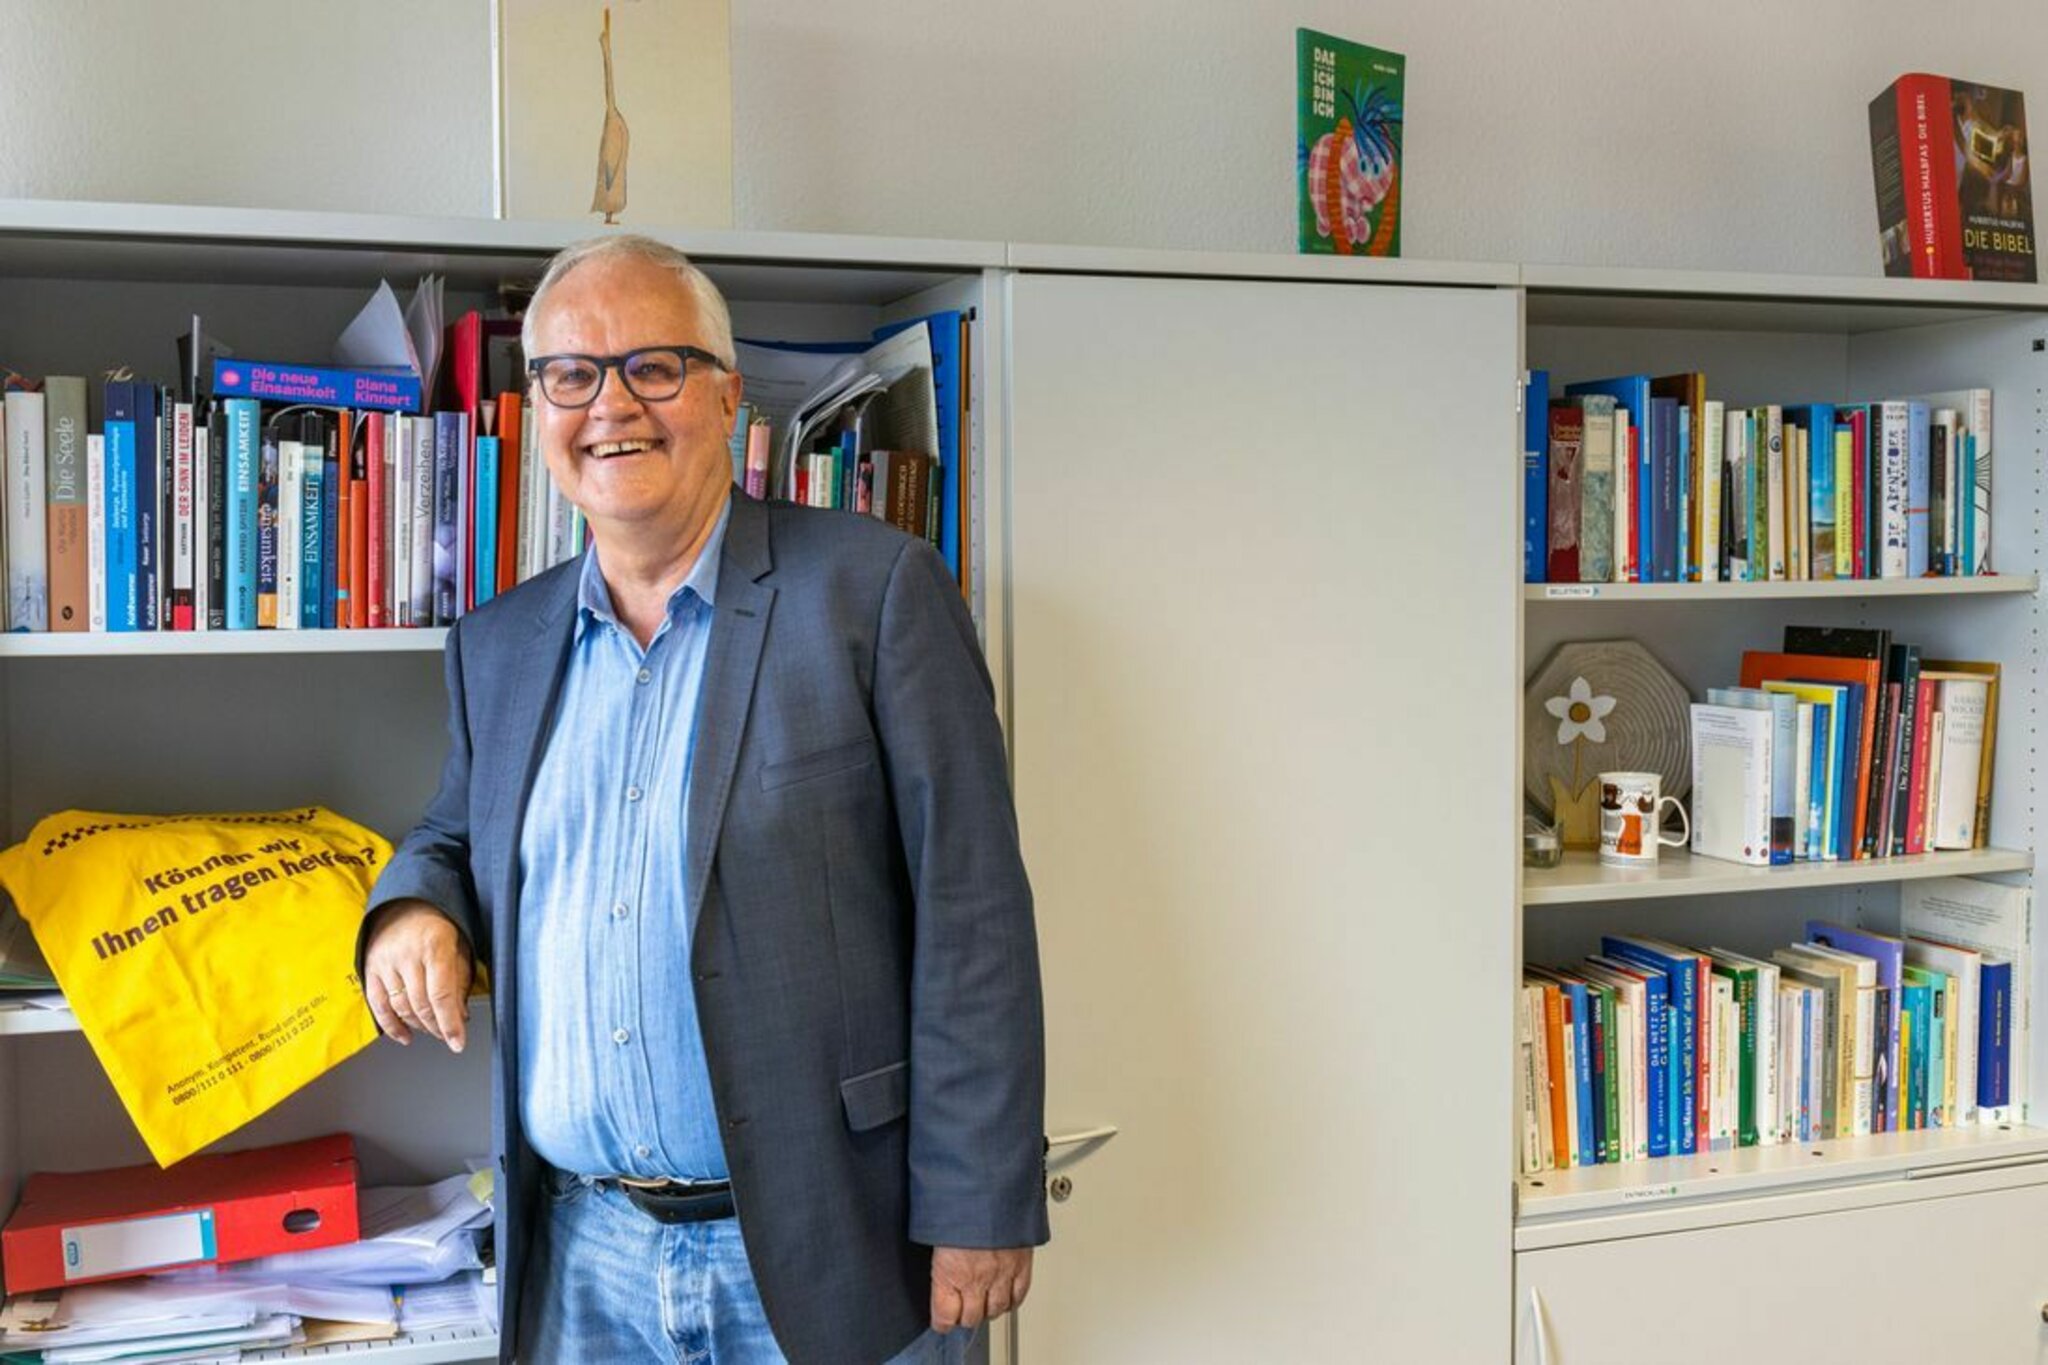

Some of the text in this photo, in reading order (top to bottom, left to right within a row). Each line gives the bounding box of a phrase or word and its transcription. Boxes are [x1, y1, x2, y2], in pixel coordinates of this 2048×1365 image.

[1313, 47, 1336, 66] DAS
[1312, 101, 1334, 119] ICH
[1917, 93, 1927, 121] BIBEL
[1918, 123, 1928, 139] DIE
[1921, 193, 1934, 245] HUBERTUS
[1964, 229, 2033, 255] DIE BIBEL
[251, 367, 318, 385] Die neue
[251, 380, 337, 399] Einsamkeit
[355, 377, 398, 393] Diana
[354, 391, 411, 407] Kinnert
[179, 412, 190, 450] LEIDEN
[54, 417, 75, 500] Die Seele
[179, 452, 190, 465] IM
[238, 408, 251, 493] EINSAMKEIT
[179, 467, 190, 493] SINN
[416, 437, 431, 520] Verzeihen
[179, 495, 190, 517] DER
[305, 478, 319, 564] EINSAMKEIT
[260, 503, 277, 583] einsamkeit
[126, 572, 136, 626] Kohlhammer
[146, 572, 156, 626] Kohlhammer
[144, 838, 302, 895] Können wir
[91, 846, 378, 961] Ihnen tragen helfen?
[1650, 994, 1658, 1013] DER
[1650, 1017, 1658, 1044] NETZ
[167, 1068, 205, 1094] Anonym.
[207, 1039, 259, 1072] Kompetent.
[258, 1022, 281, 1042] Rund
[226, 1061, 245, 1077] 111
